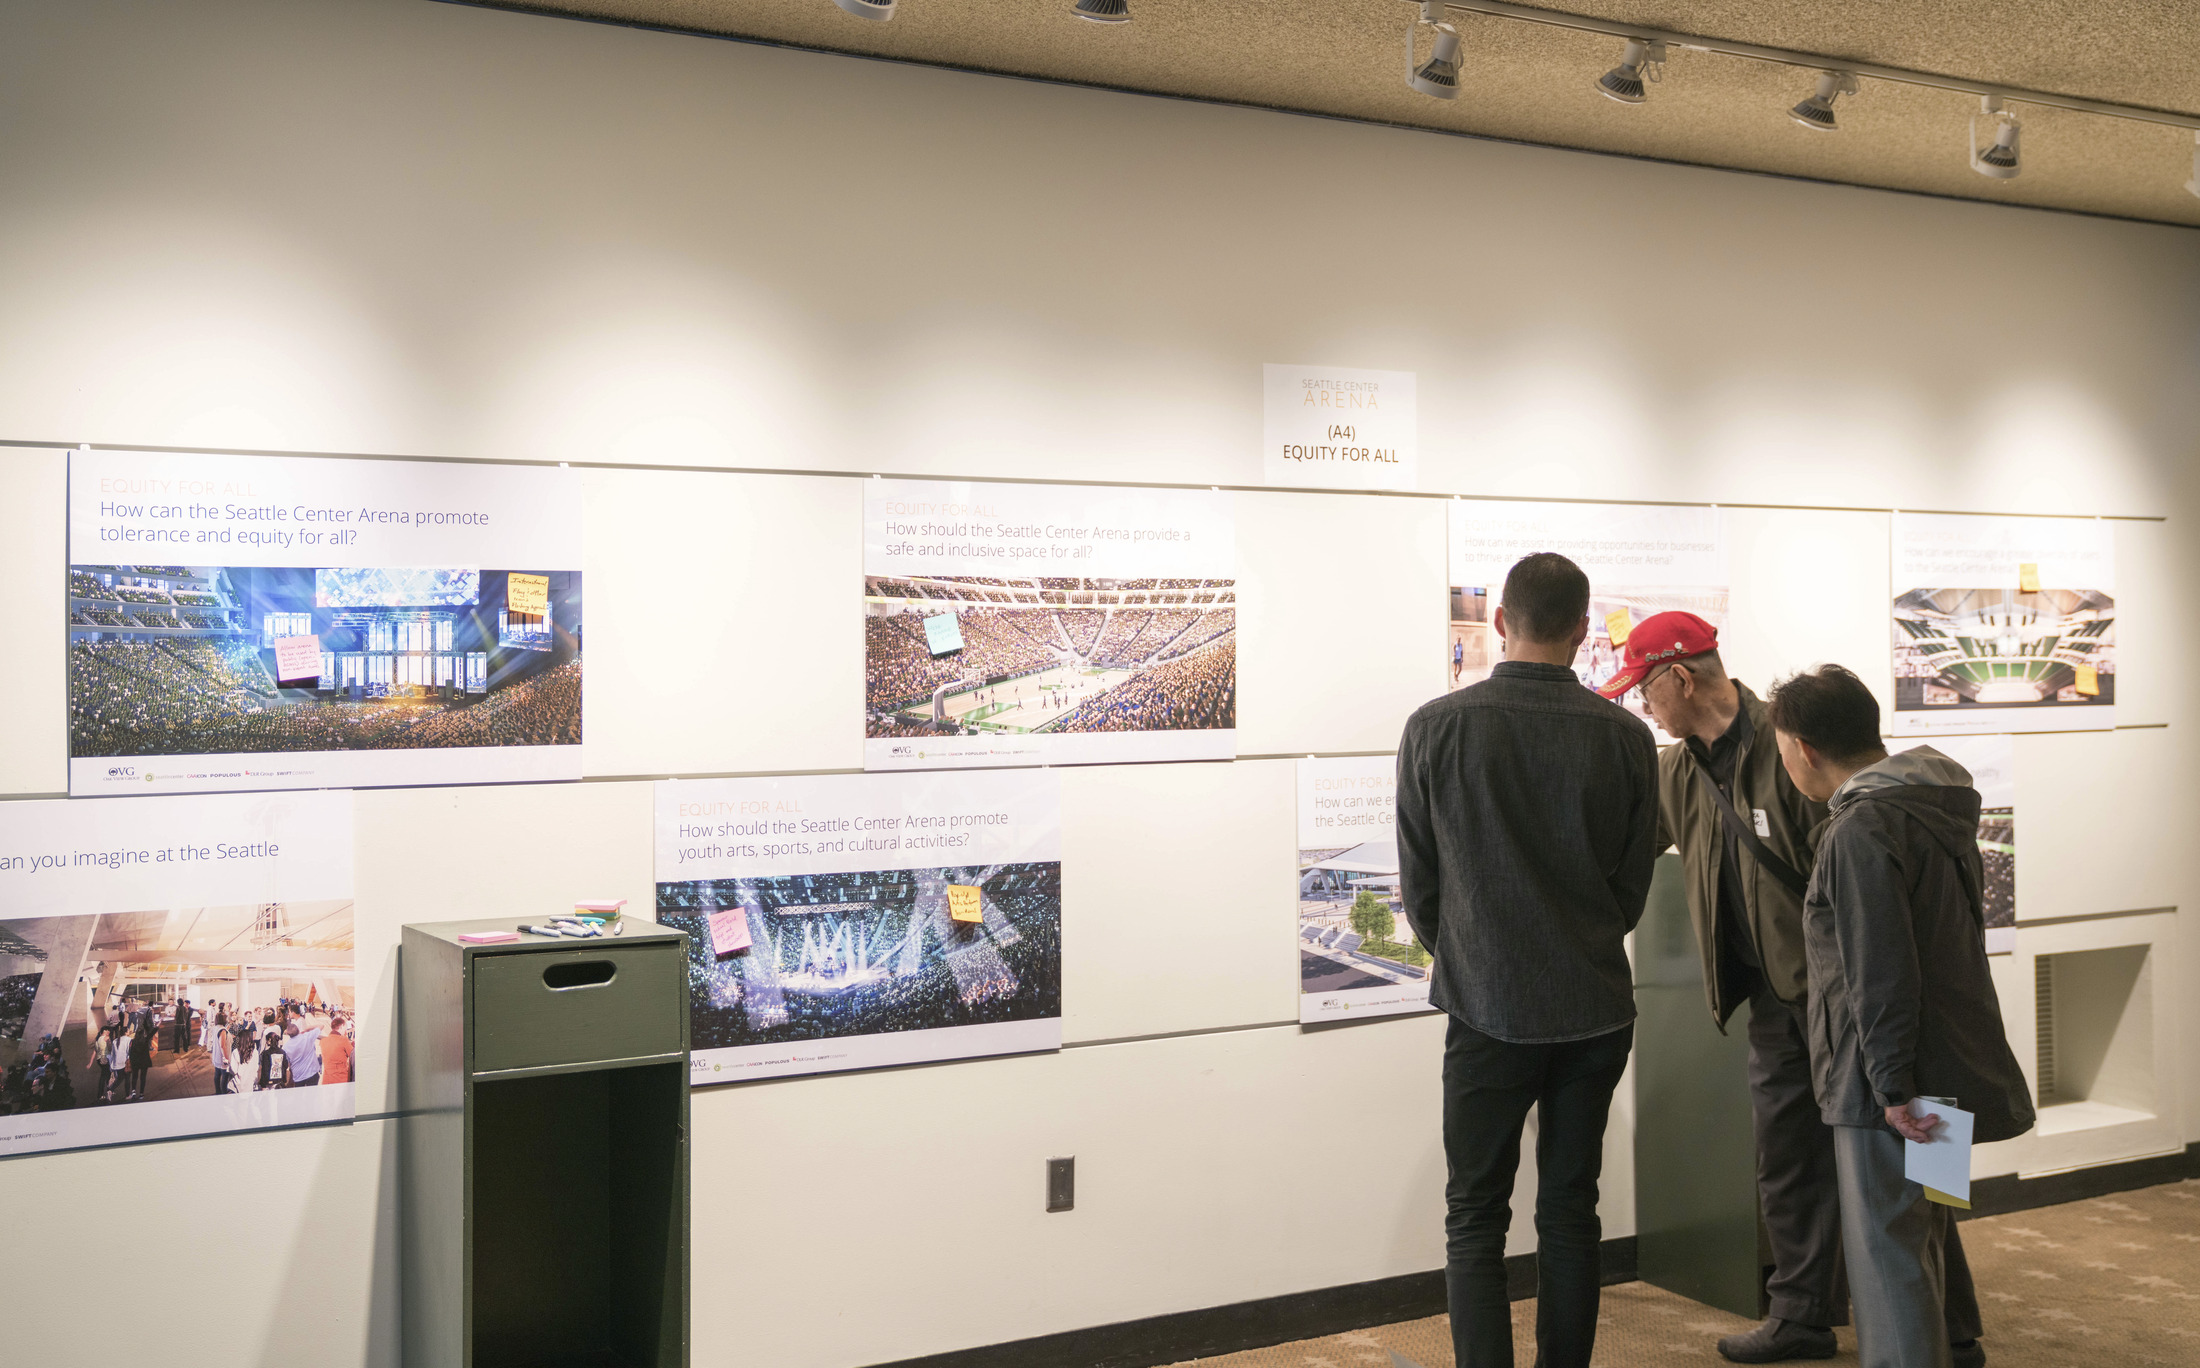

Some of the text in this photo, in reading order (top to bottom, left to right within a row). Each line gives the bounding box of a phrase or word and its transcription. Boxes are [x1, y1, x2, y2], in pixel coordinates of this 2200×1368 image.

[1302, 379, 1379, 392] SEATTLE CENTER
[1303, 390, 1378, 409] ARENA
[1328, 424, 1356, 442] (A4)
[1283, 444, 1399, 463] EQUITY FOR ALL
[101, 478, 257, 497] EQUITY FOR ALL
[101, 501, 489, 528] How can the Seattle Center Arena promote
[886, 502, 999, 518] EQUITY FOR ALL
[886, 521, 1191, 543] How should the Seattle Center Arena provide a
[1465, 519, 1549, 533] EQUITY FOR ALL
[100, 525, 357, 549] tolerance and equity for all?
[1465, 536, 1715, 552] How can we assist in providing opportunities for businesses
[886, 541, 1093, 561] safe and inclusive space for all?
[1465, 552, 1474, 562] to
[1476, 552, 1502, 563] thrive
[1504, 553, 1513, 563] at
[1584, 553, 1613, 565] Seattle
[1615, 554, 1642, 565] Center
[1645, 554, 1674, 566] Arena?
[1315, 777, 1357, 791] EQUITY
[1360, 776, 1382, 789] FOR
[679, 799, 804, 817] EQUITY FOR ALL
[1315, 796, 1340, 809] How
[1343, 797, 1363, 808] can
[1366, 796, 1382, 807] we
[679, 812, 1009, 838] How should the Seattle Center Arena promote
[1315, 814, 1334, 828] the
[1337, 811, 1375, 827] Seattle
[30, 854, 66, 874] you
[74, 848, 150, 870] imagine
[156, 847, 174, 862] at
[180, 844, 210, 861] the
[216, 840, 279, 860] Seattle
[678, 832, 970, 864] youth arts, sports, and cultural activities?
